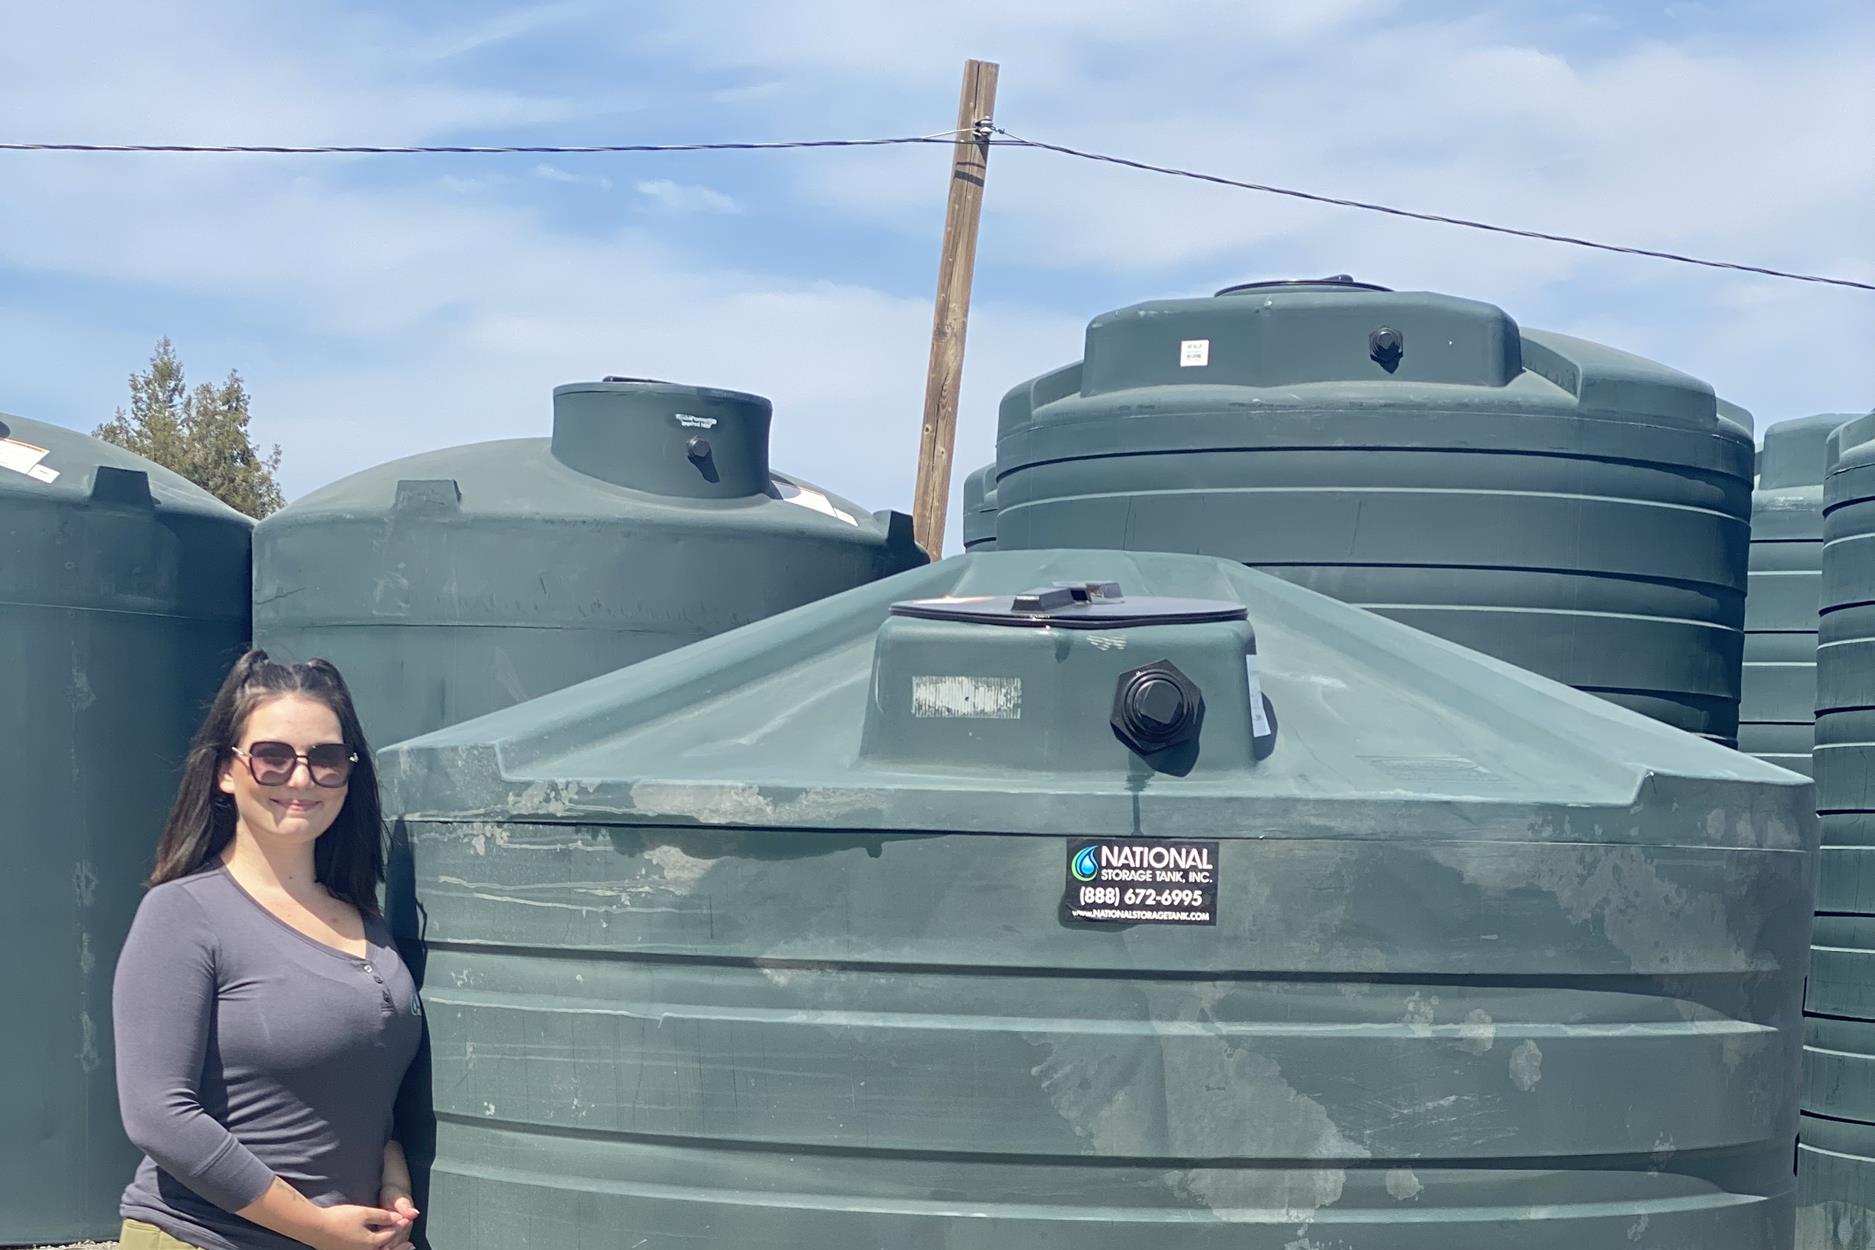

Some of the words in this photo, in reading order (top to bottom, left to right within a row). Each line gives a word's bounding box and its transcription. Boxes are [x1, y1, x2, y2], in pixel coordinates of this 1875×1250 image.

[1101, 845, 1213, 869] NATIONAL
[1101, 869, 1153, 881] STORAGE
[1156, 870, 1185, 883] TANK,
[1189, 871, 1213, 883] INC.
[1079, 886, 1120, 906] (888)
[1124, 888, 1203, 906] 672-6995
